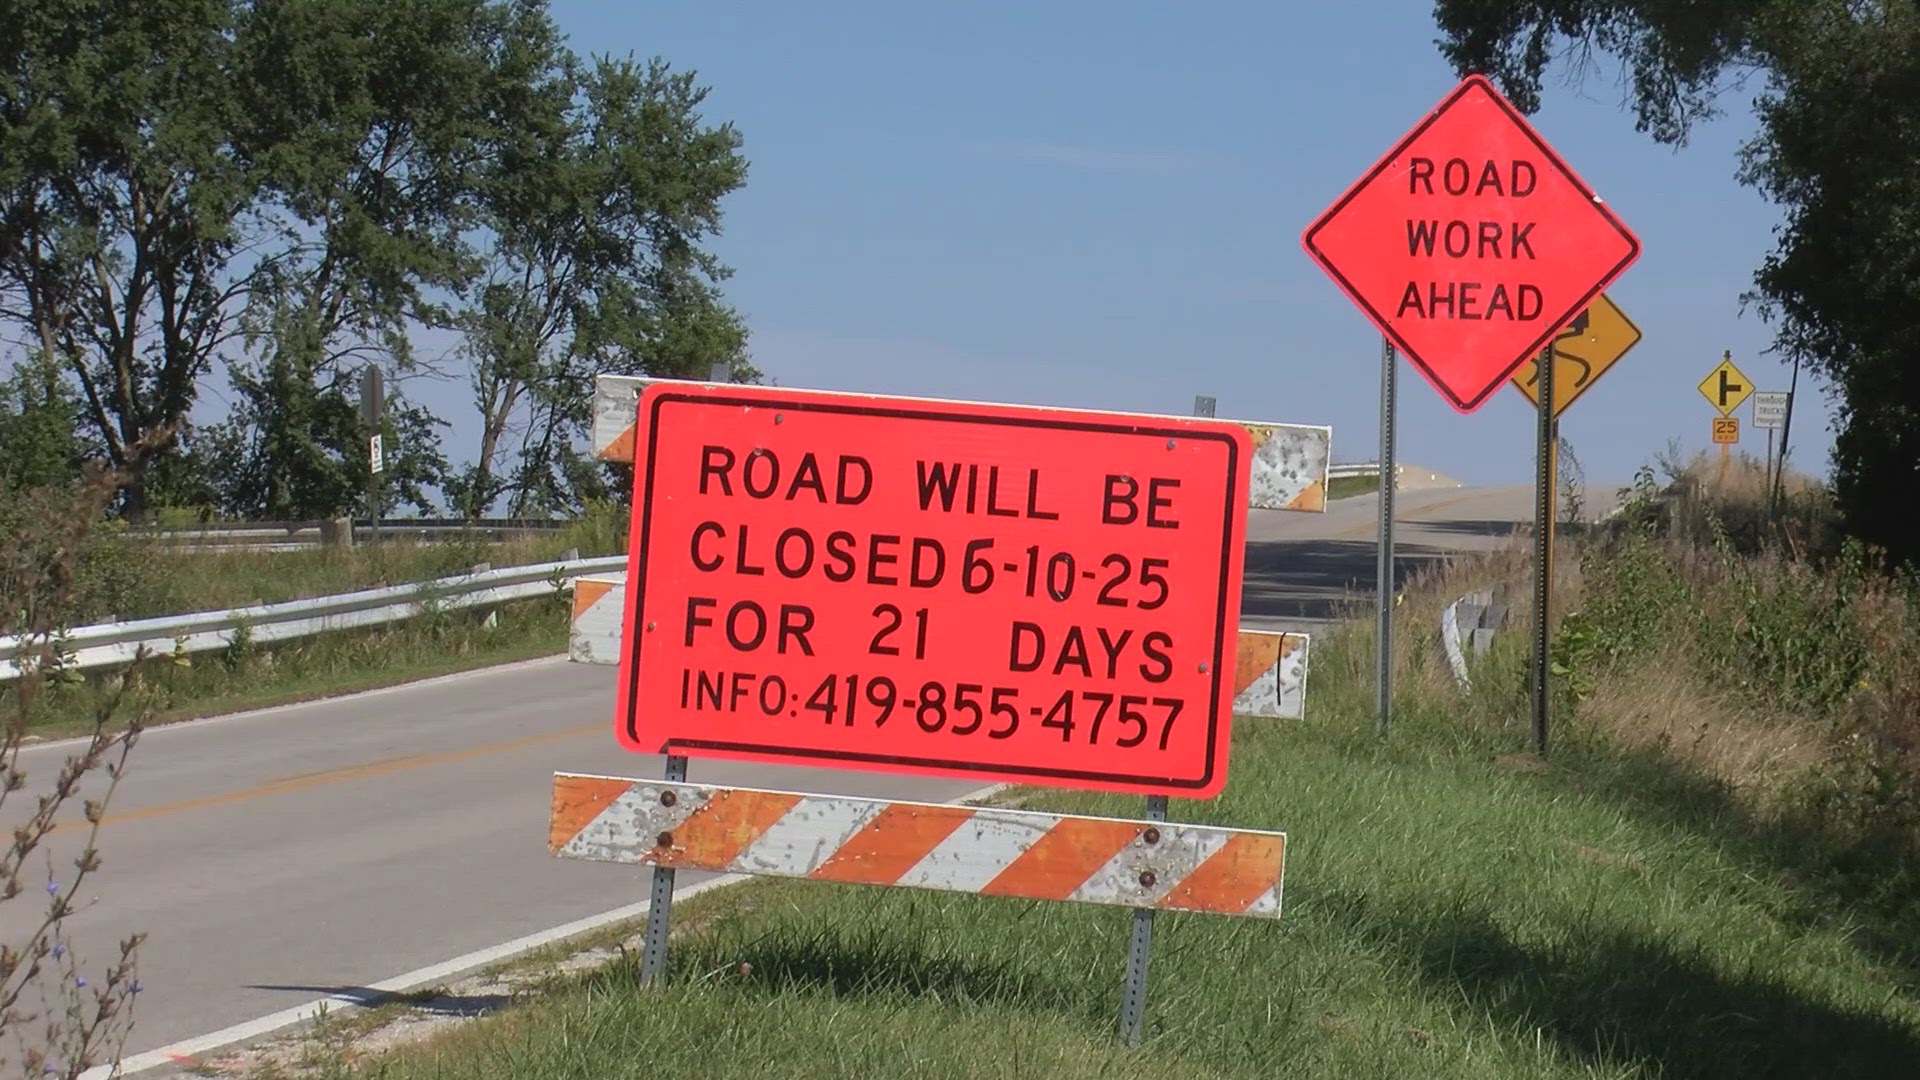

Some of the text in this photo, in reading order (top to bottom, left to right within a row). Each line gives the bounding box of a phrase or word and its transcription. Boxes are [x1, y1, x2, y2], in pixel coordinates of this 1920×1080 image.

[1409, 157, 1537, 197] ROAD
[1407, 219, 1536, 260] WORK
[1396, 281, 1543, 321] AHEAD
[1716, 421, 1736, 433] 25
[699, 445, 1181, 529] ROAD WILL BE
[690, 521, 1169, 610] CLOSED 6-10-25
[684, 596, 1173, 684] FOR 21 DAYS
